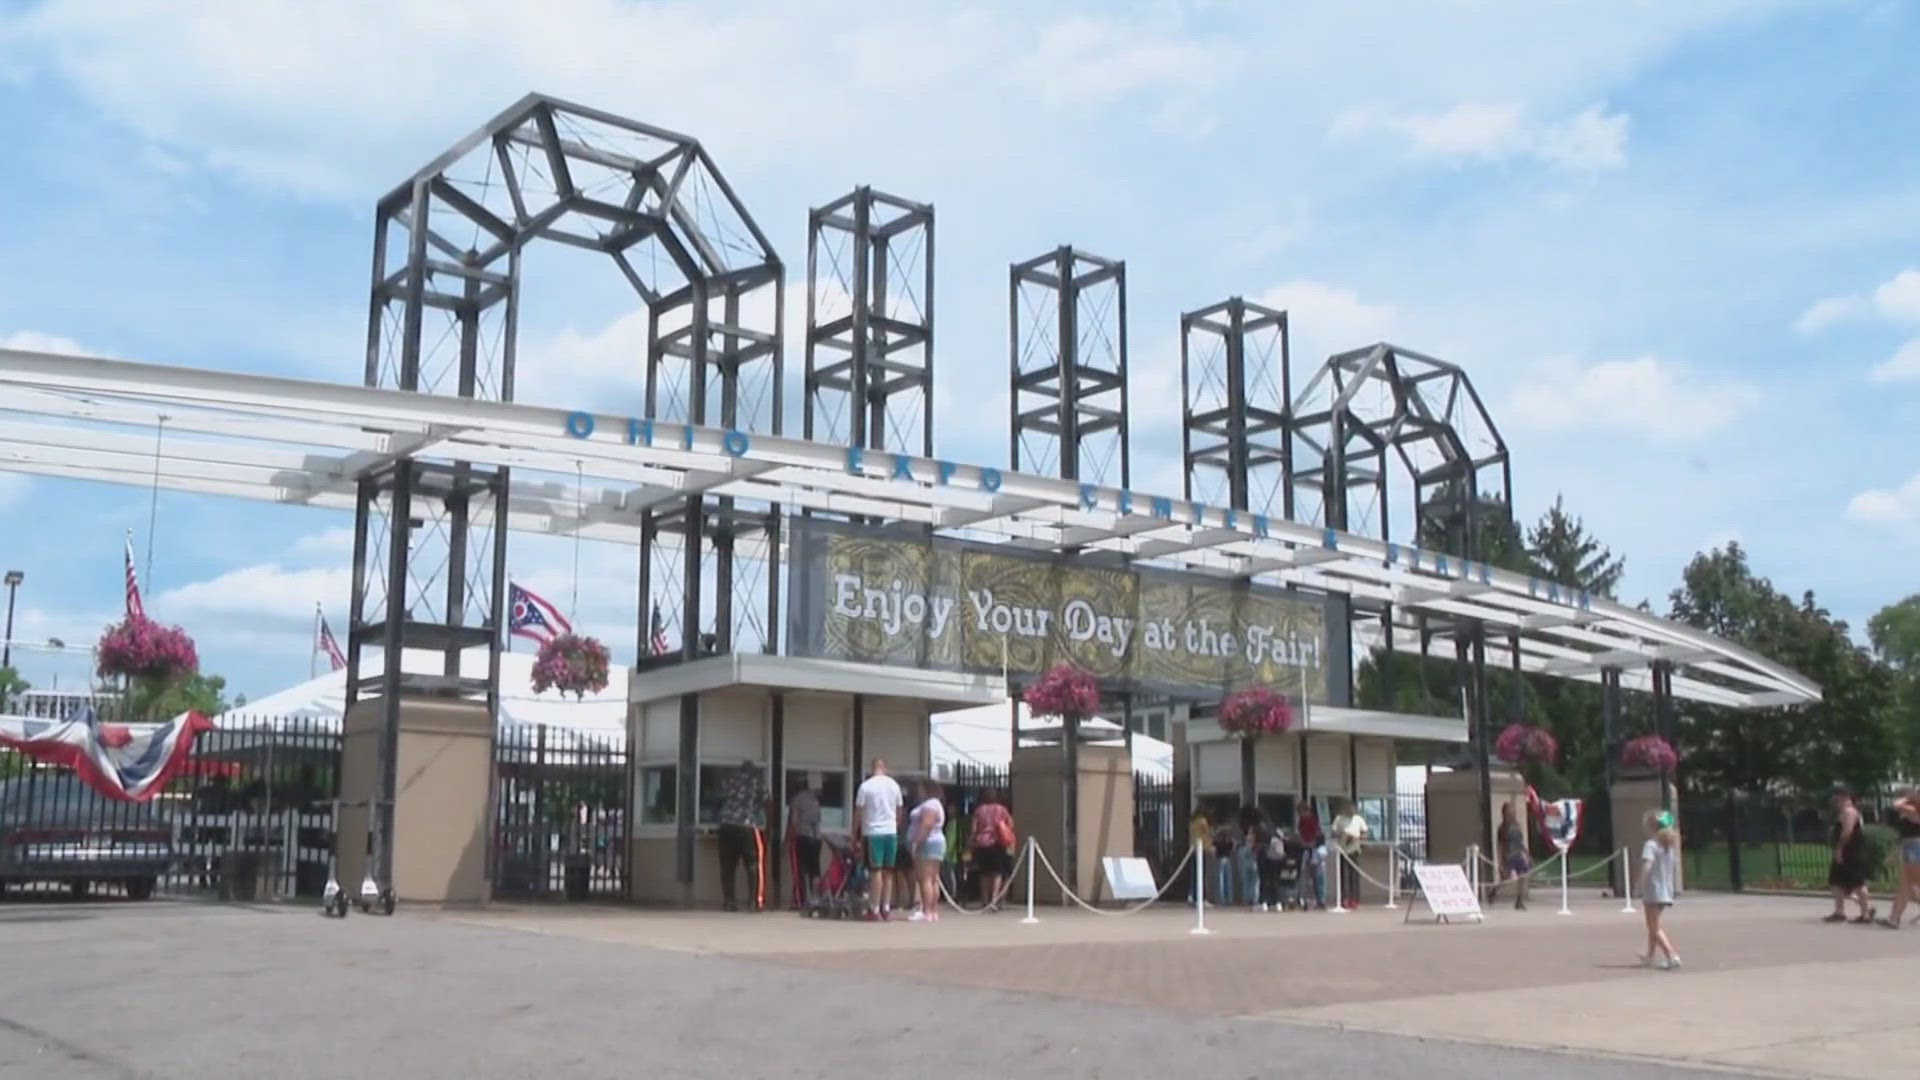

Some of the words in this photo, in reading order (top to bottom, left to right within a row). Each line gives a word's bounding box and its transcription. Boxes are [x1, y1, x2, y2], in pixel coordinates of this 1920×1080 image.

[567, 411, 750, 457] OHIO
[847, 446, 1003, 492] EXPO
[833, 574, 954, 638] Enjoy
[969, 590, 1053, 637] Your
[1064, 600, 1135, 657] Day
[1144, 618, 1177, 650] at
[1184, 621, 1238, 657] the
[1246, 623, 1321, 669] Fair!
